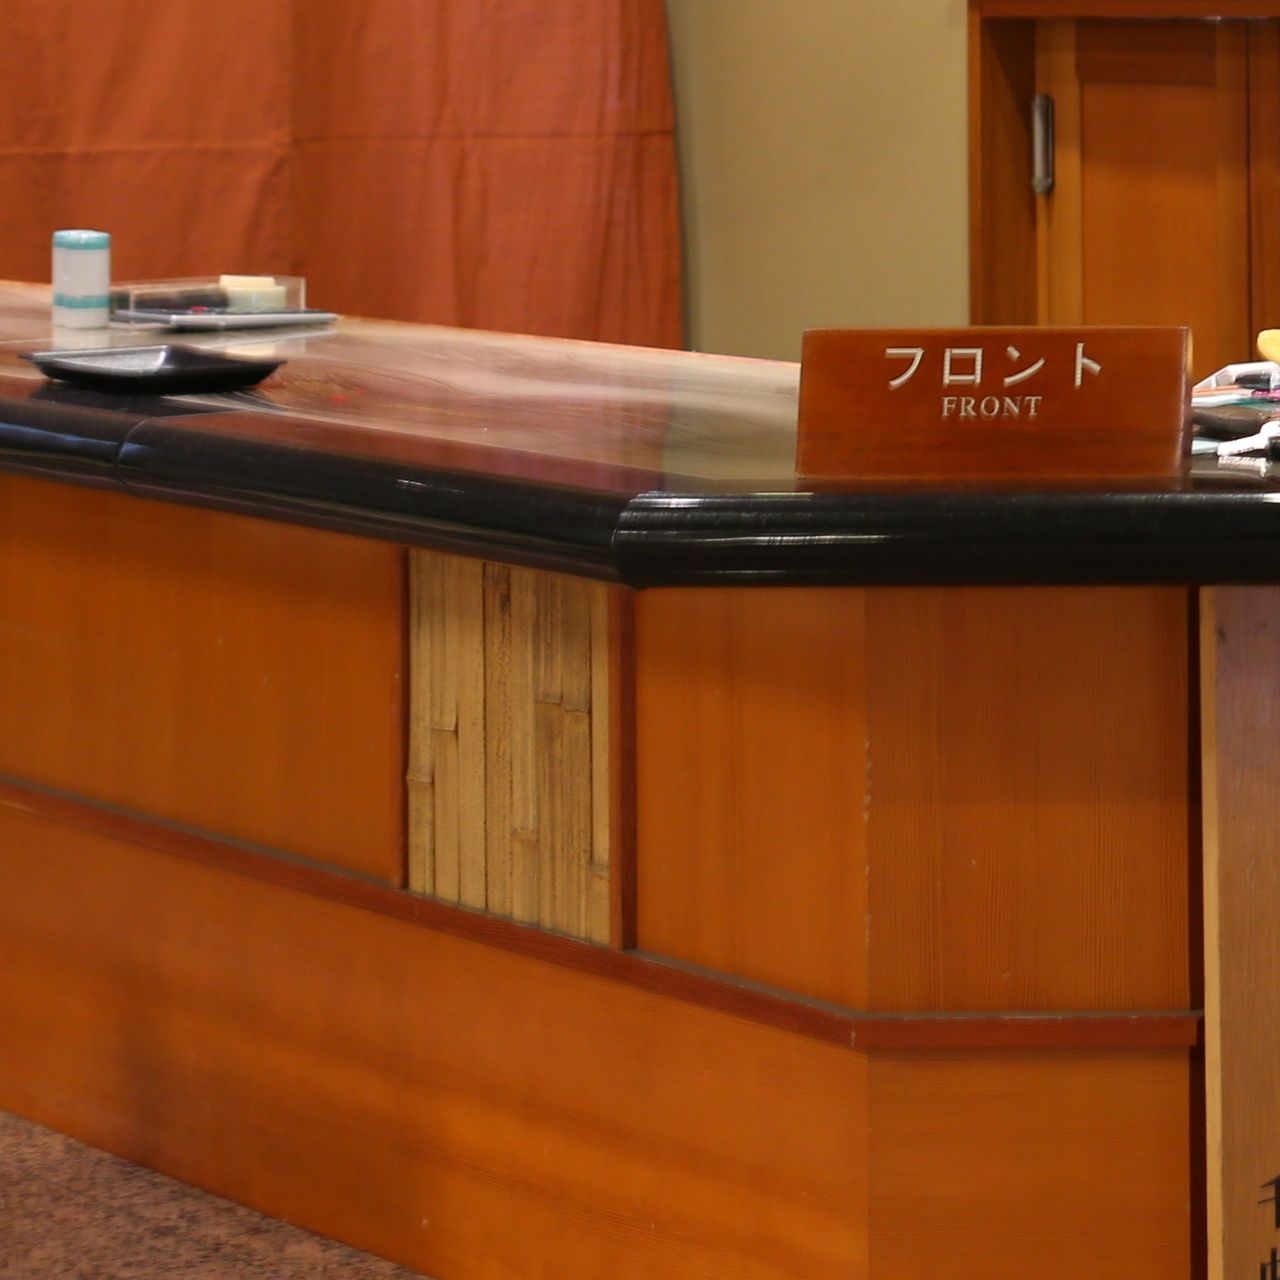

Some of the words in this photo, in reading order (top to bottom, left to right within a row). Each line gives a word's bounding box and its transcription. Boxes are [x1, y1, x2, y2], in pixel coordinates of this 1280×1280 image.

[885, 342, 1102, 390] フロント
[940, 395, 1043, 419] FRONT
